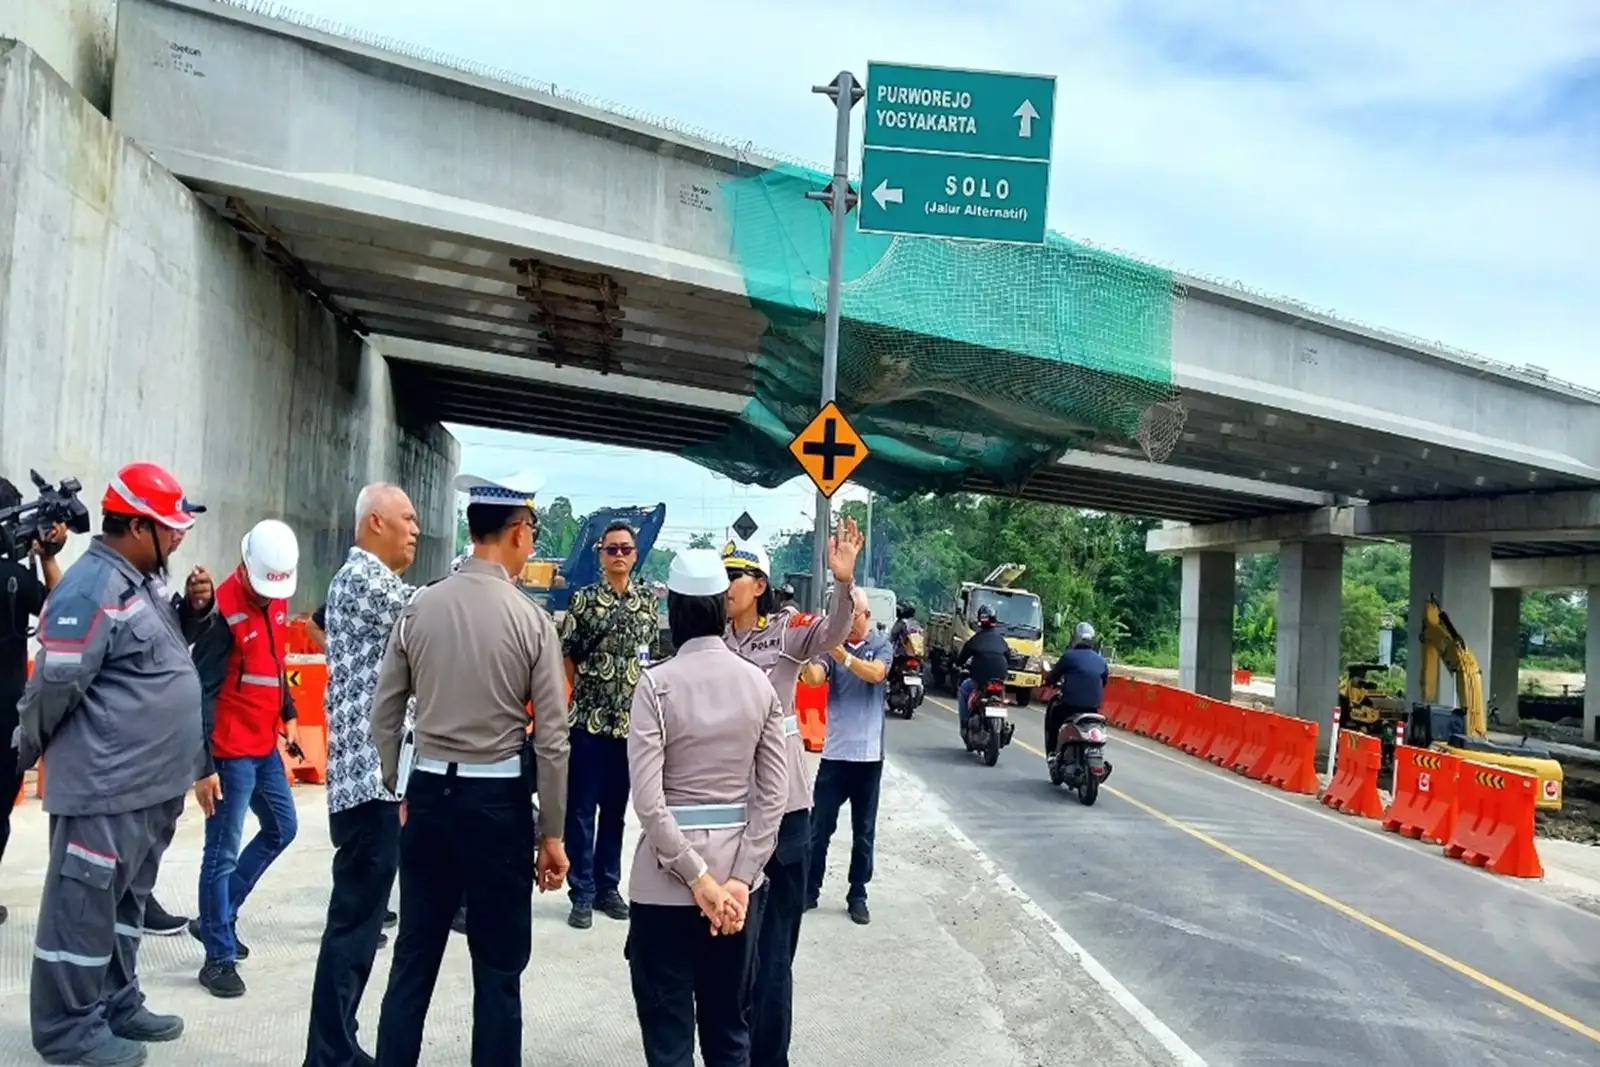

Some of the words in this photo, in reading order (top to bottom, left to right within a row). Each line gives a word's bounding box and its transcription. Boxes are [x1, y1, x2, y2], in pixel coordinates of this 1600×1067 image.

[877, 85, 972, 109] PURWOREJO
[876, 110, 977, 134] YOGYAKARTA
[945, 175, 1009, 200] SOLO
[924, 201, 960, 216] (Jalur
[964, 204, 1028, 222] Alternatif)
[751, 637, 780, 651] POLRI
